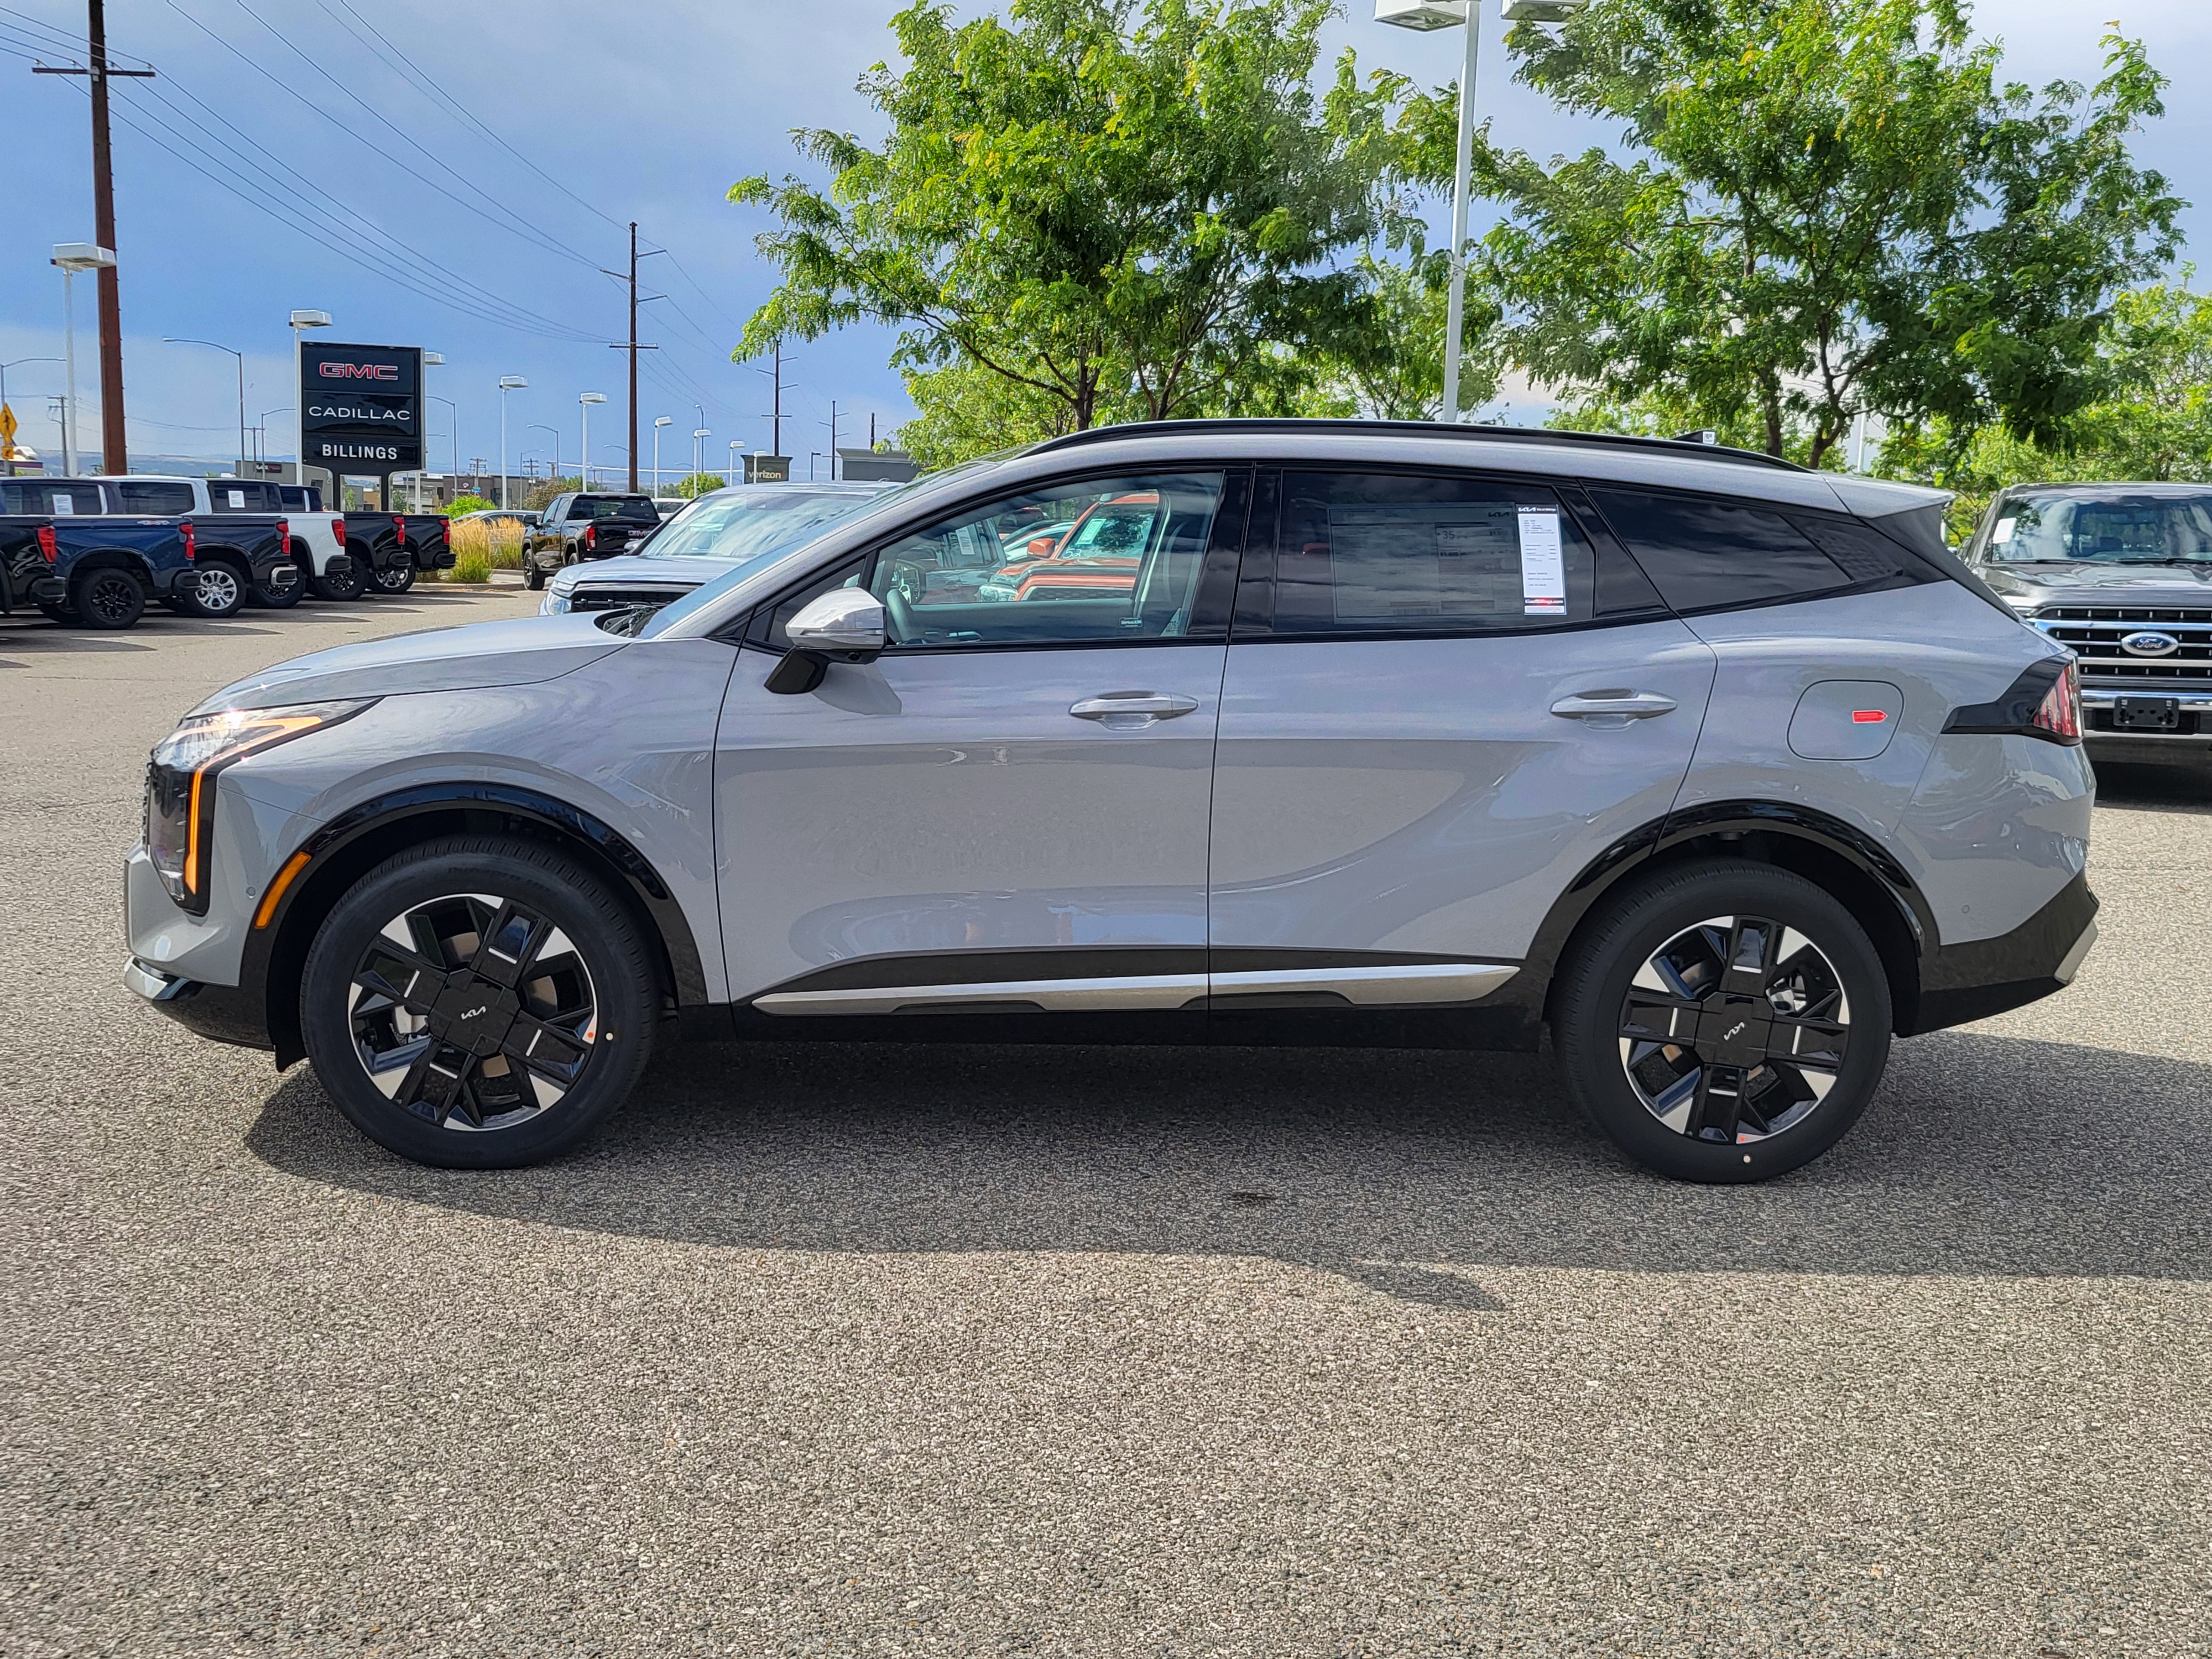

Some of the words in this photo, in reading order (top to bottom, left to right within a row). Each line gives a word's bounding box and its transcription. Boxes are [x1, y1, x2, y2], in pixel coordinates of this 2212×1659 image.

[319, 362, 398, 380] GMC
[309, 406, 410, 420] CADILLAC
[322, 444, 397, 460] BILLINGS
[1442, 530, 1455, 540] 35
[2136, 638, 2164, 648] Ford
[461, 1005, 487, 1020] KIA
